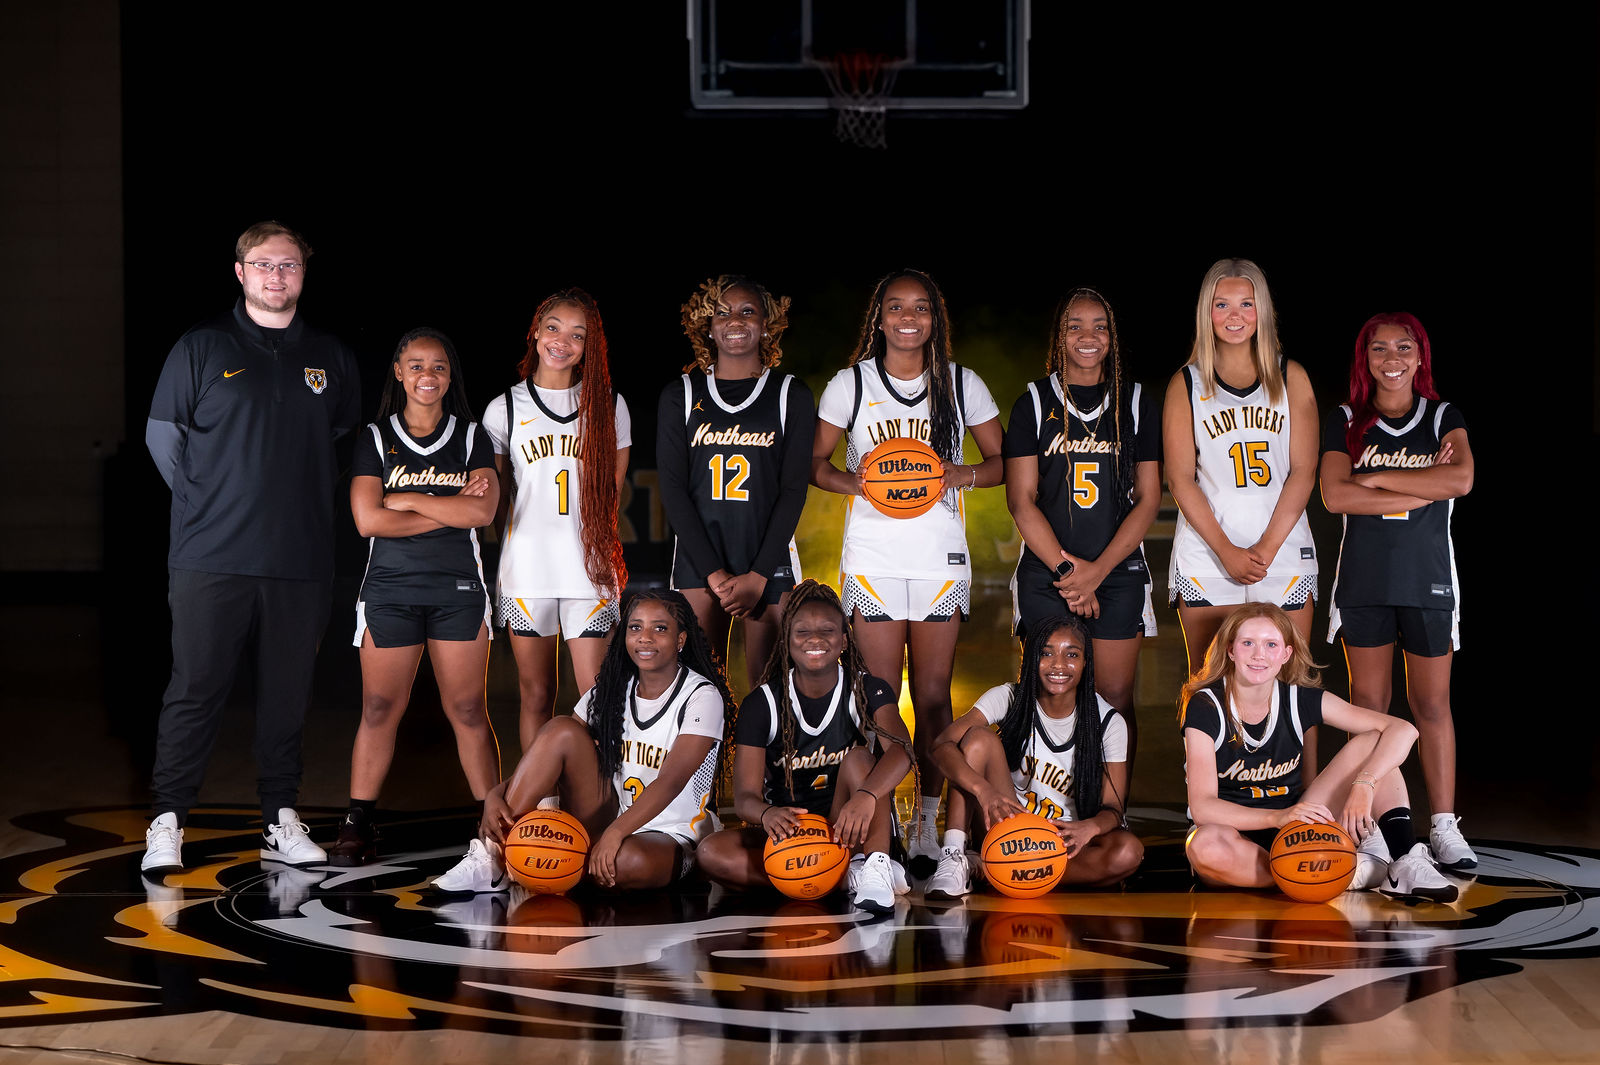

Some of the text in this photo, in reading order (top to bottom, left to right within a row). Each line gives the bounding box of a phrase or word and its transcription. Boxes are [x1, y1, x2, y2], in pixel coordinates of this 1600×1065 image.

[867, 418, 932, 446] LADY TIG
[1202, 406, 1285, 440] LADY TIGERS
[691, 423, 776, 448] Northeast
[521, 434, 554, 464] LADY
[1353, 444, 1438, 469] Northeas
[878, 458, 932, 475] Wilson
[1228, 441, 1272, 488] 15
[385, 465, 467, 489] Northeast
[708, 454, 750, 501] 12
[1073, 462, 1100, 509] 5
[555, 469, 569, 515] 1
[886, 486, 928, 500] NCAA
[1218, 753, 1301, 782] Northeast
[519, 824, 574, 845] Wilson
[999, 836, 1057, 856] Wilson
[1284, 829, 1343, 848] Wilson
[524, 856, 560, 870] EVO
[785, 853, 819, 871] EVO
[1011, 864, 1054, 881] NCAA
[1297, 859, 1331, 873] EVO
